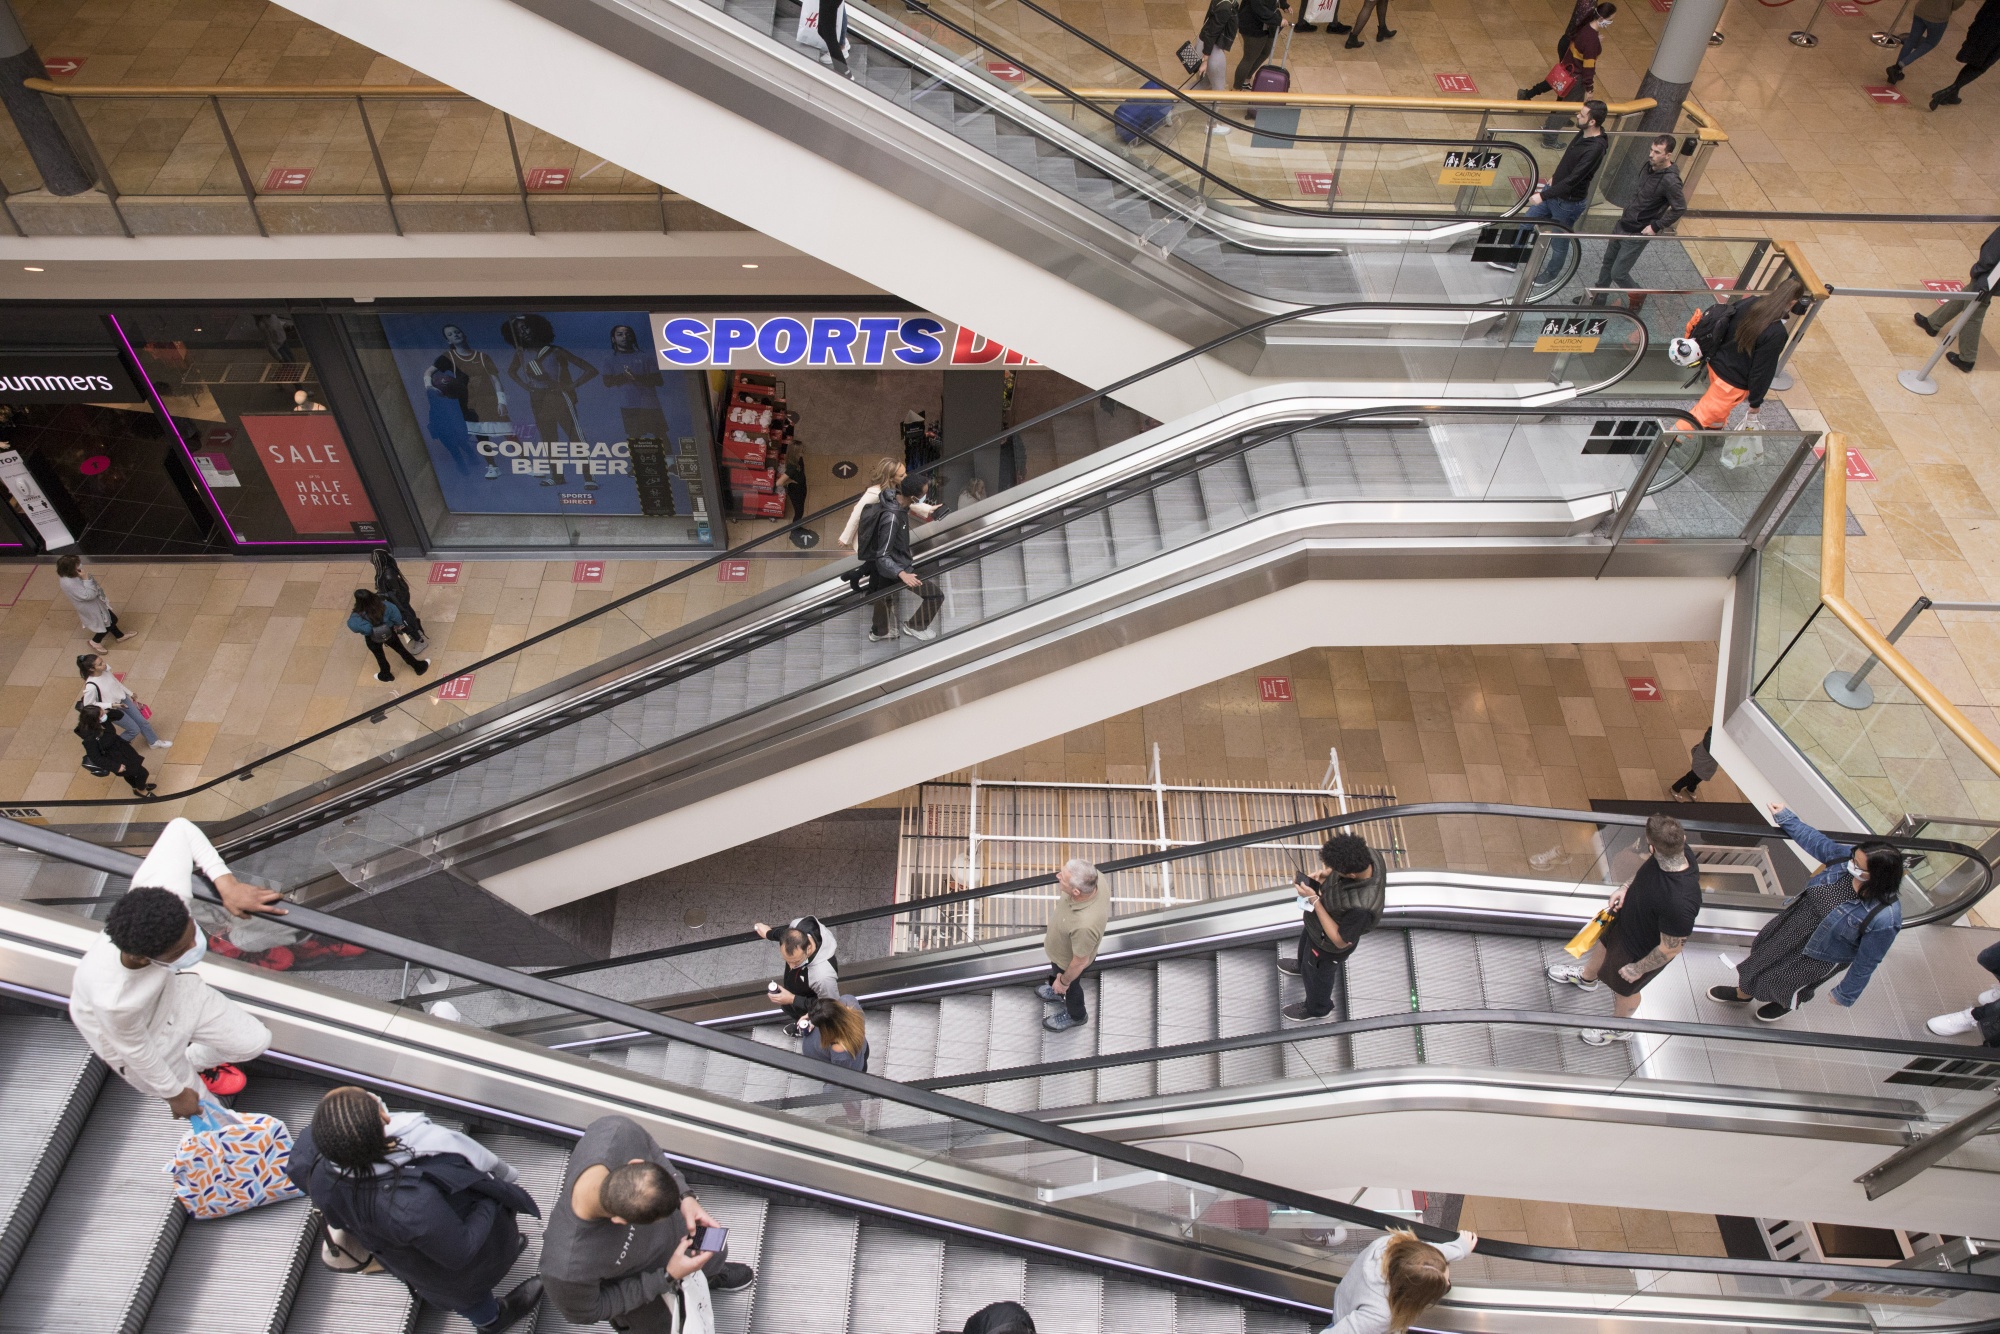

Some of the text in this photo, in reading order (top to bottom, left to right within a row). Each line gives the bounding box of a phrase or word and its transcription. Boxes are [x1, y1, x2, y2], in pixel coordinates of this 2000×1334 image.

[660, 317, 945, 366] SPORTS
[268, 444, 340, 464] SALE
[476, 440, 631, 458] COMEBAC
[0, 456, 18, 465] TOP
[511, 459, 629, 475] BETTER
[295, 480, 341, 493] HALF
[298, 493, 352, 506] PRICE
[615, 1225, 636, 1265] TOMMY
